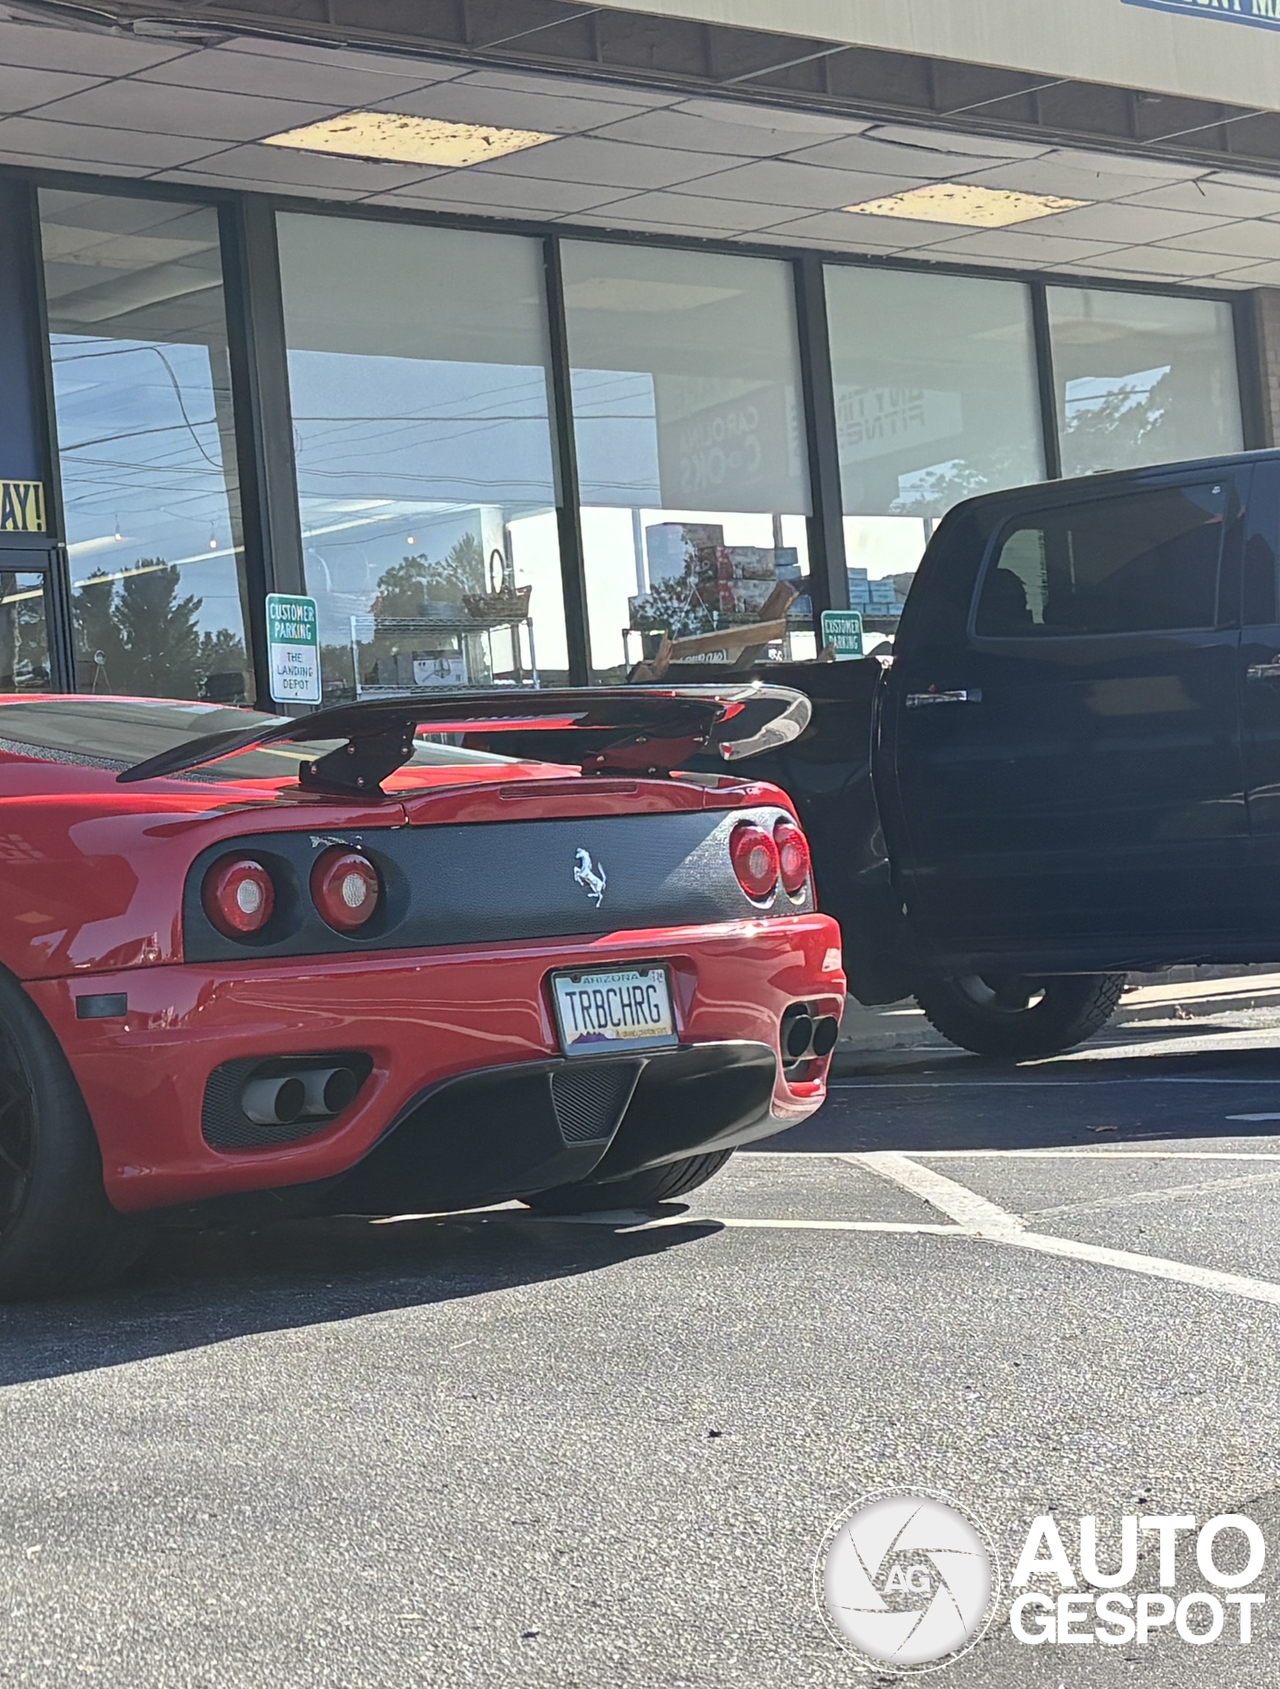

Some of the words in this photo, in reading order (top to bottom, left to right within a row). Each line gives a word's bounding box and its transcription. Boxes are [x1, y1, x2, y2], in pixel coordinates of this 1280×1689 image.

[270, 602, 314, 621] CUSTOMER
[274, 622, 311, 640] PARKING
[287, 652, 303, 664] THE
[277, 665, 313, 678] LANDING
[283, 678, 309, 691] DEPOT
[582, 972, 640, 985] ARIZONA
[565, 984, 662, 1032] TRBCHRG
